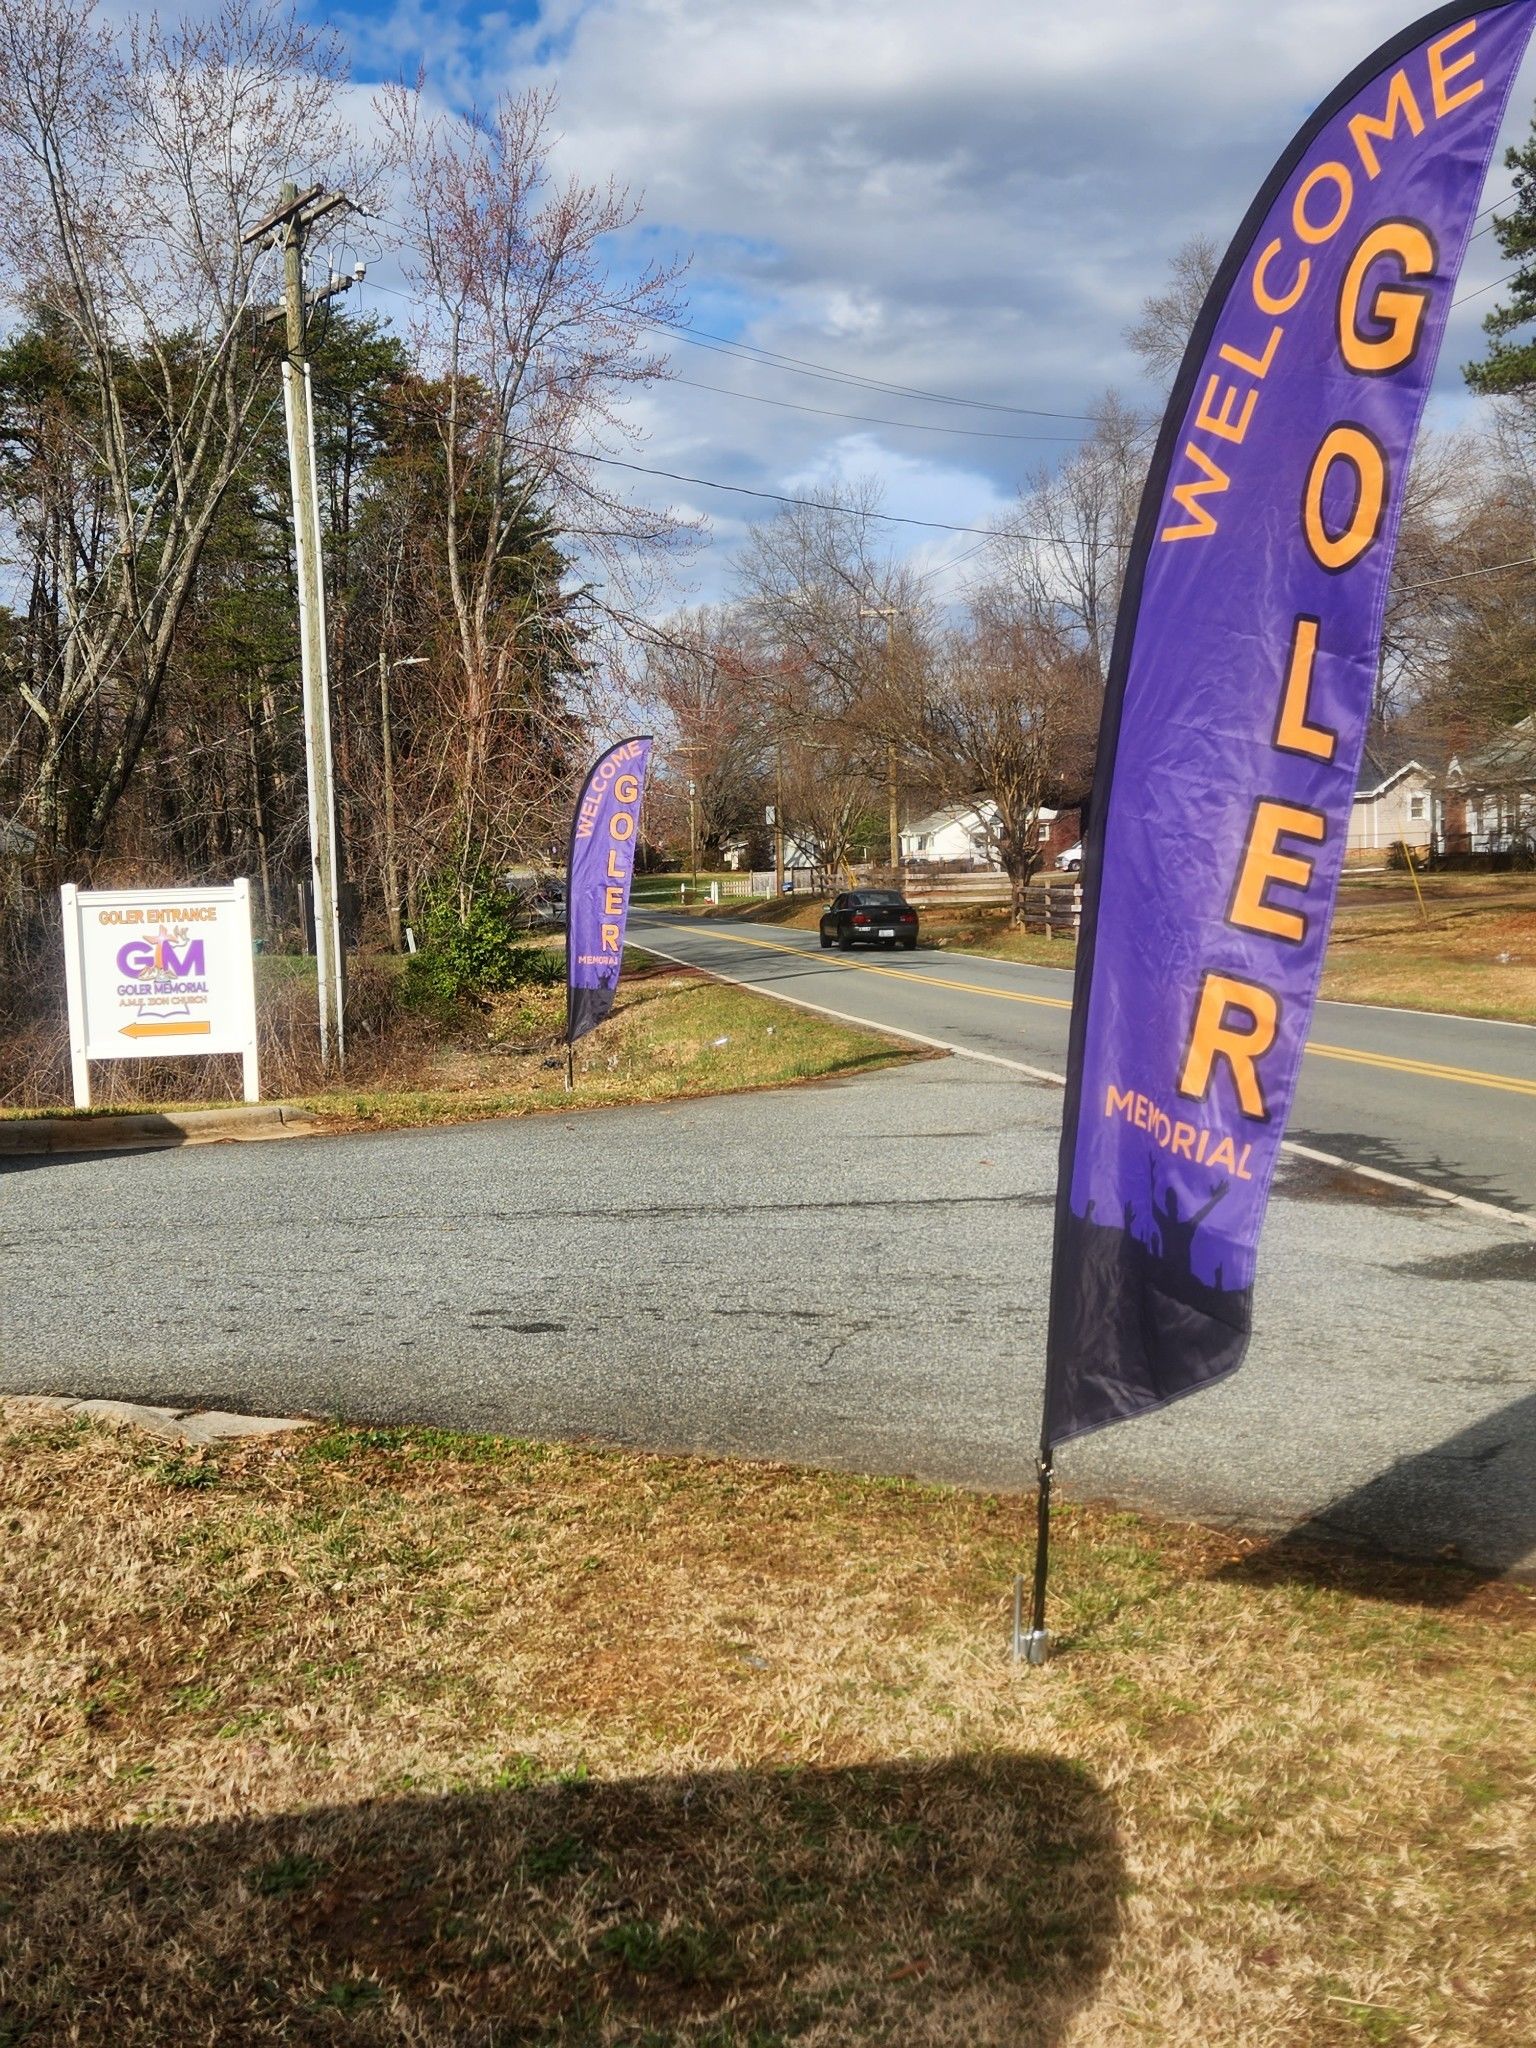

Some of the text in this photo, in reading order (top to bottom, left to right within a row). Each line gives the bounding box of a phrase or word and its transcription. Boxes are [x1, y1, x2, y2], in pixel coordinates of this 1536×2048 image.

[1160, 19, 1485, 543] WELCOME
[1175, 217, 1440, 1123] GOLER
[575, 740, 643, 839] WELCOME
[599, 773, 640, 953] GOLER
[99, 907, 217, 925] GOLER ENTRANCE
[117, 981, 209, 997] GOLER MEMORIAL
[147, 996, 170, 1006] ZION
[170, 995, 208, 1005] CHURCH
[1104, 1084, 1253, 1181] MEMORIAL
